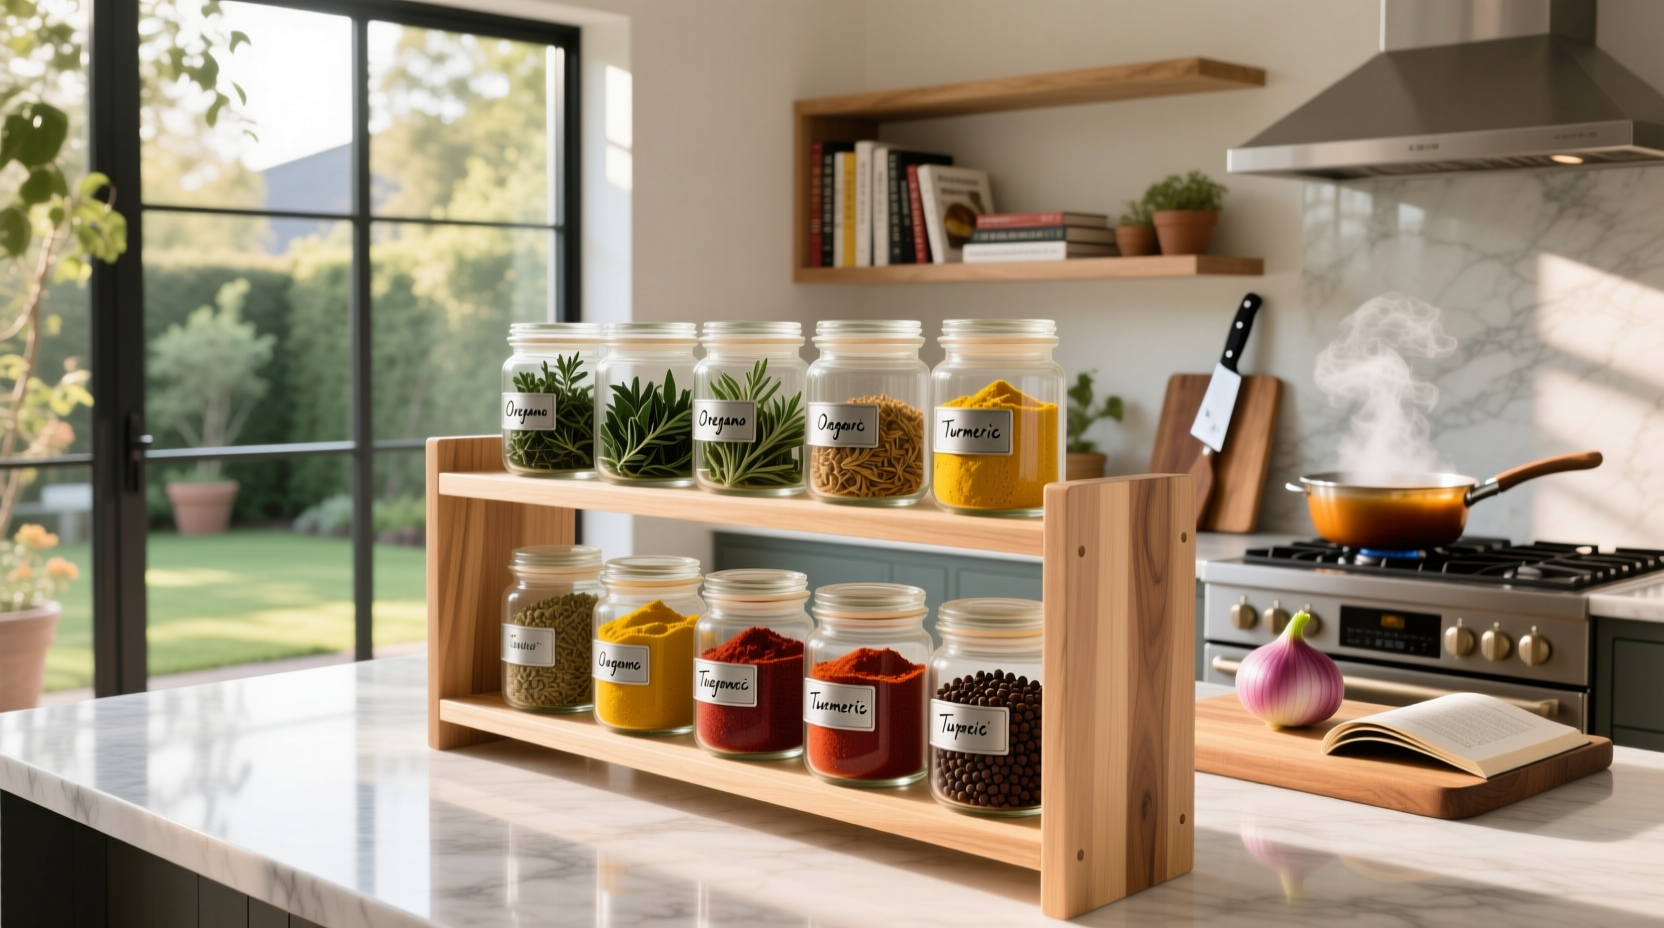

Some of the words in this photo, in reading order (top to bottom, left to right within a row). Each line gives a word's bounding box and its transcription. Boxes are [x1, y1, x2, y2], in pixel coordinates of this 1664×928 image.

[505, 400, 548, 424] Oregano
[698, 409, 747, 435] Oregano
[941, 420, 1000, 439] Turmeric
